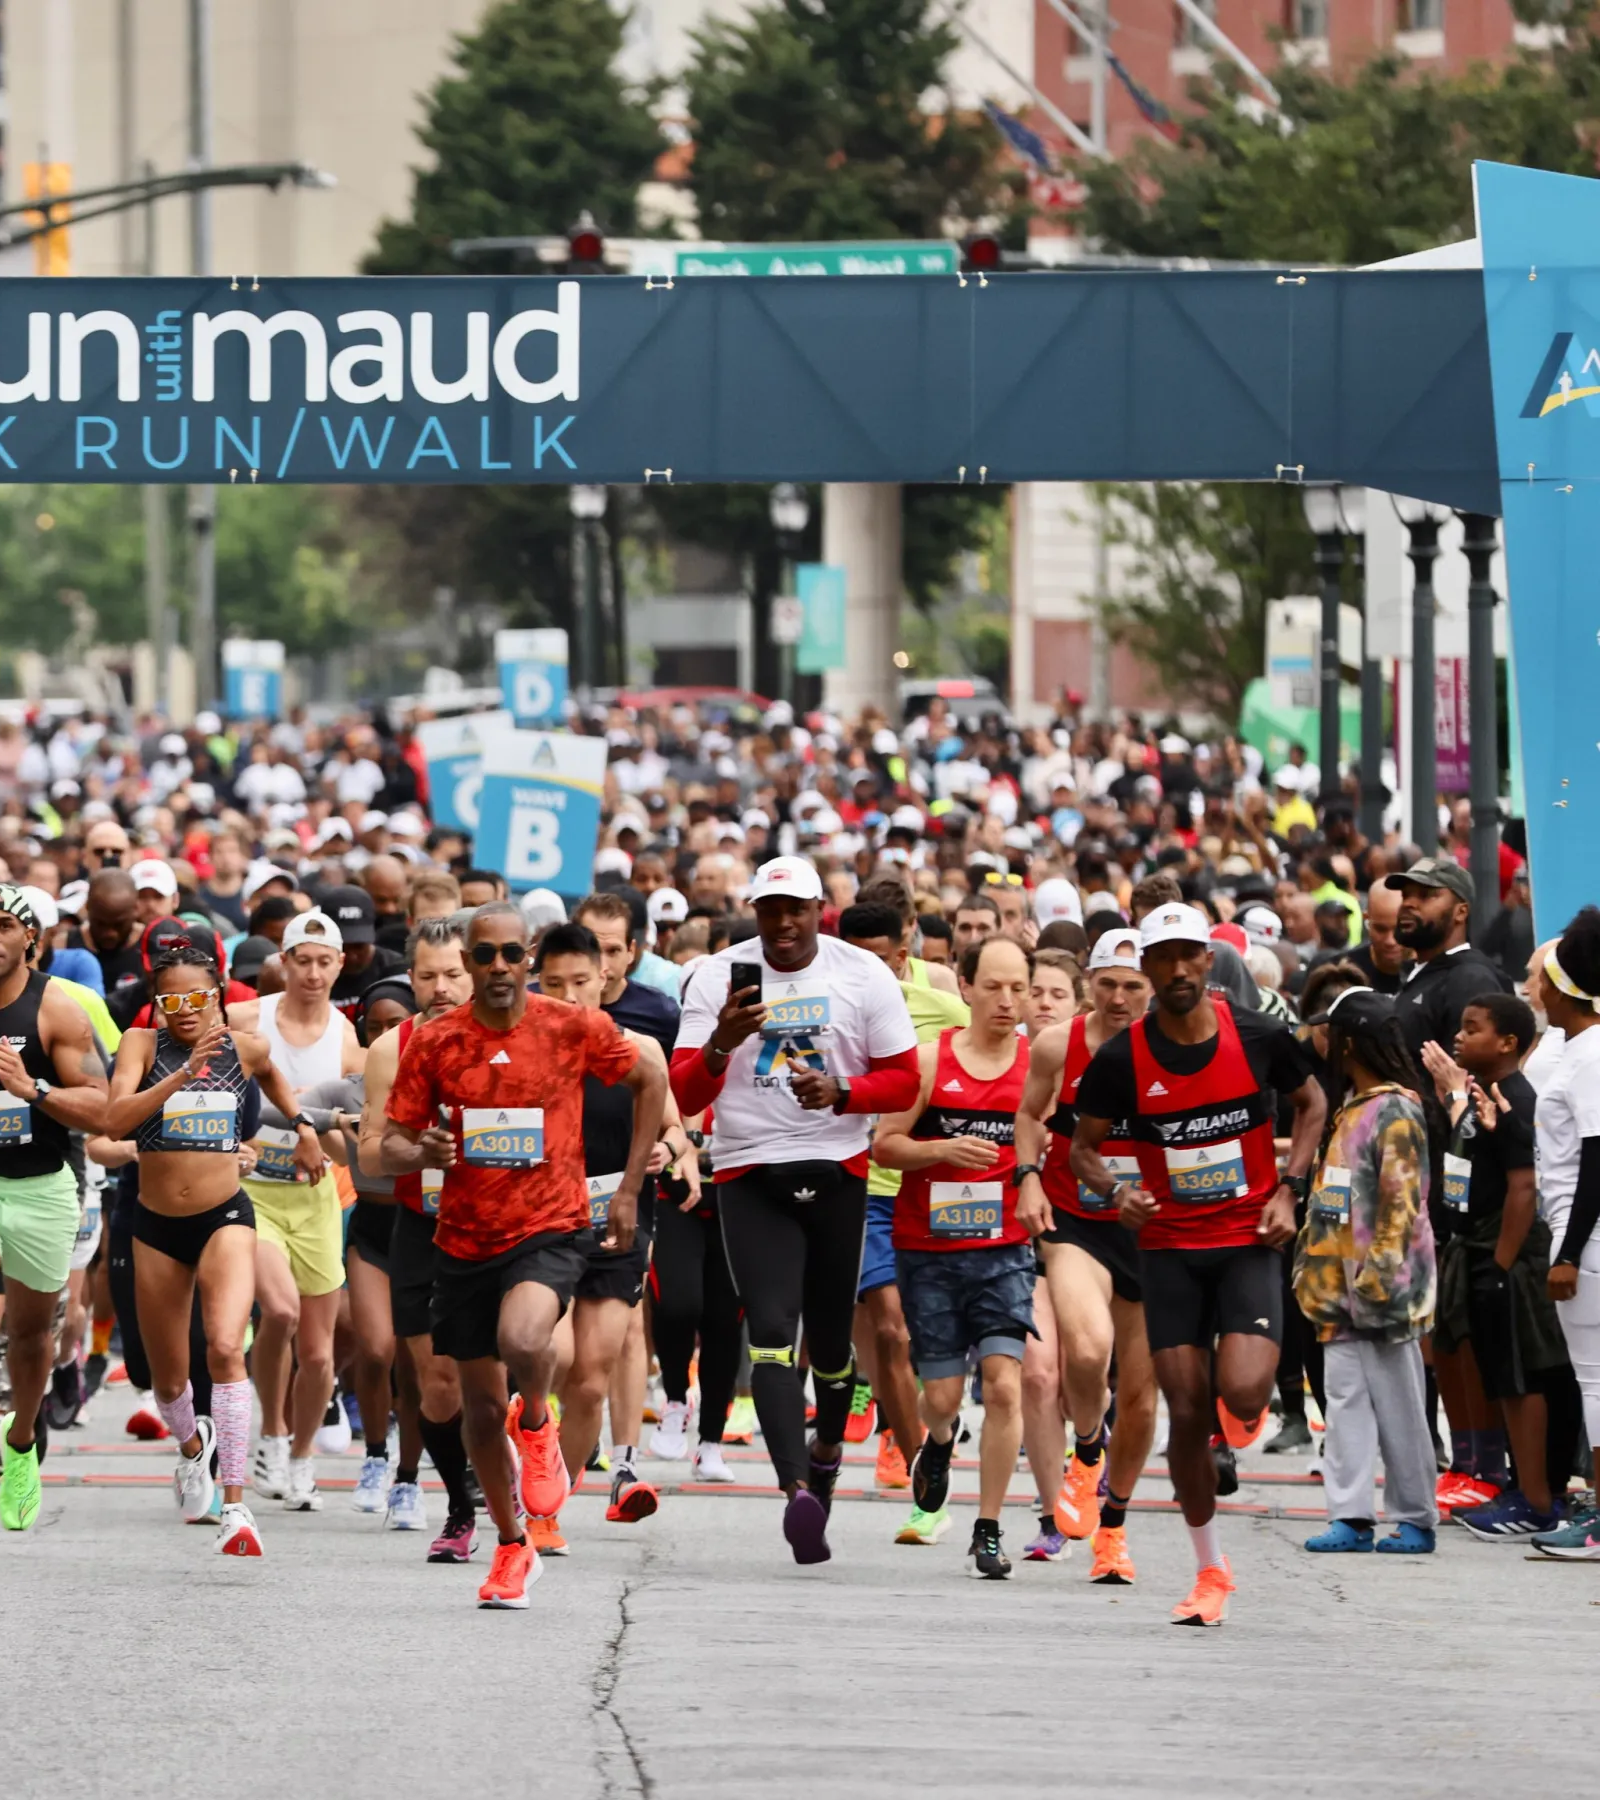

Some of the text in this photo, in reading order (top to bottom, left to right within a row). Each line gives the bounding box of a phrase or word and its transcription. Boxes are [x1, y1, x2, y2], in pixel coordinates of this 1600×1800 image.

[145, 309, 182, 401] with
[193, 281, 580, 403] maud
[76, 408, 578, 478] RUN/WALK
[514, 672, 554, 717] D
[505, 806, 563, 881] B
[764, 1004, 824, 1024] A3219
[168, 1118, 228, 1135] A3103
[967, 1121, 1016, 1134] ATLANT
[1185, 1108, 1249, 1133] ATLANTA
[471, 1136, 536, 1153] A3018
[1175, 1168, 1239, 1189] B3694
[936, 1208, 997, 1224] A3180
